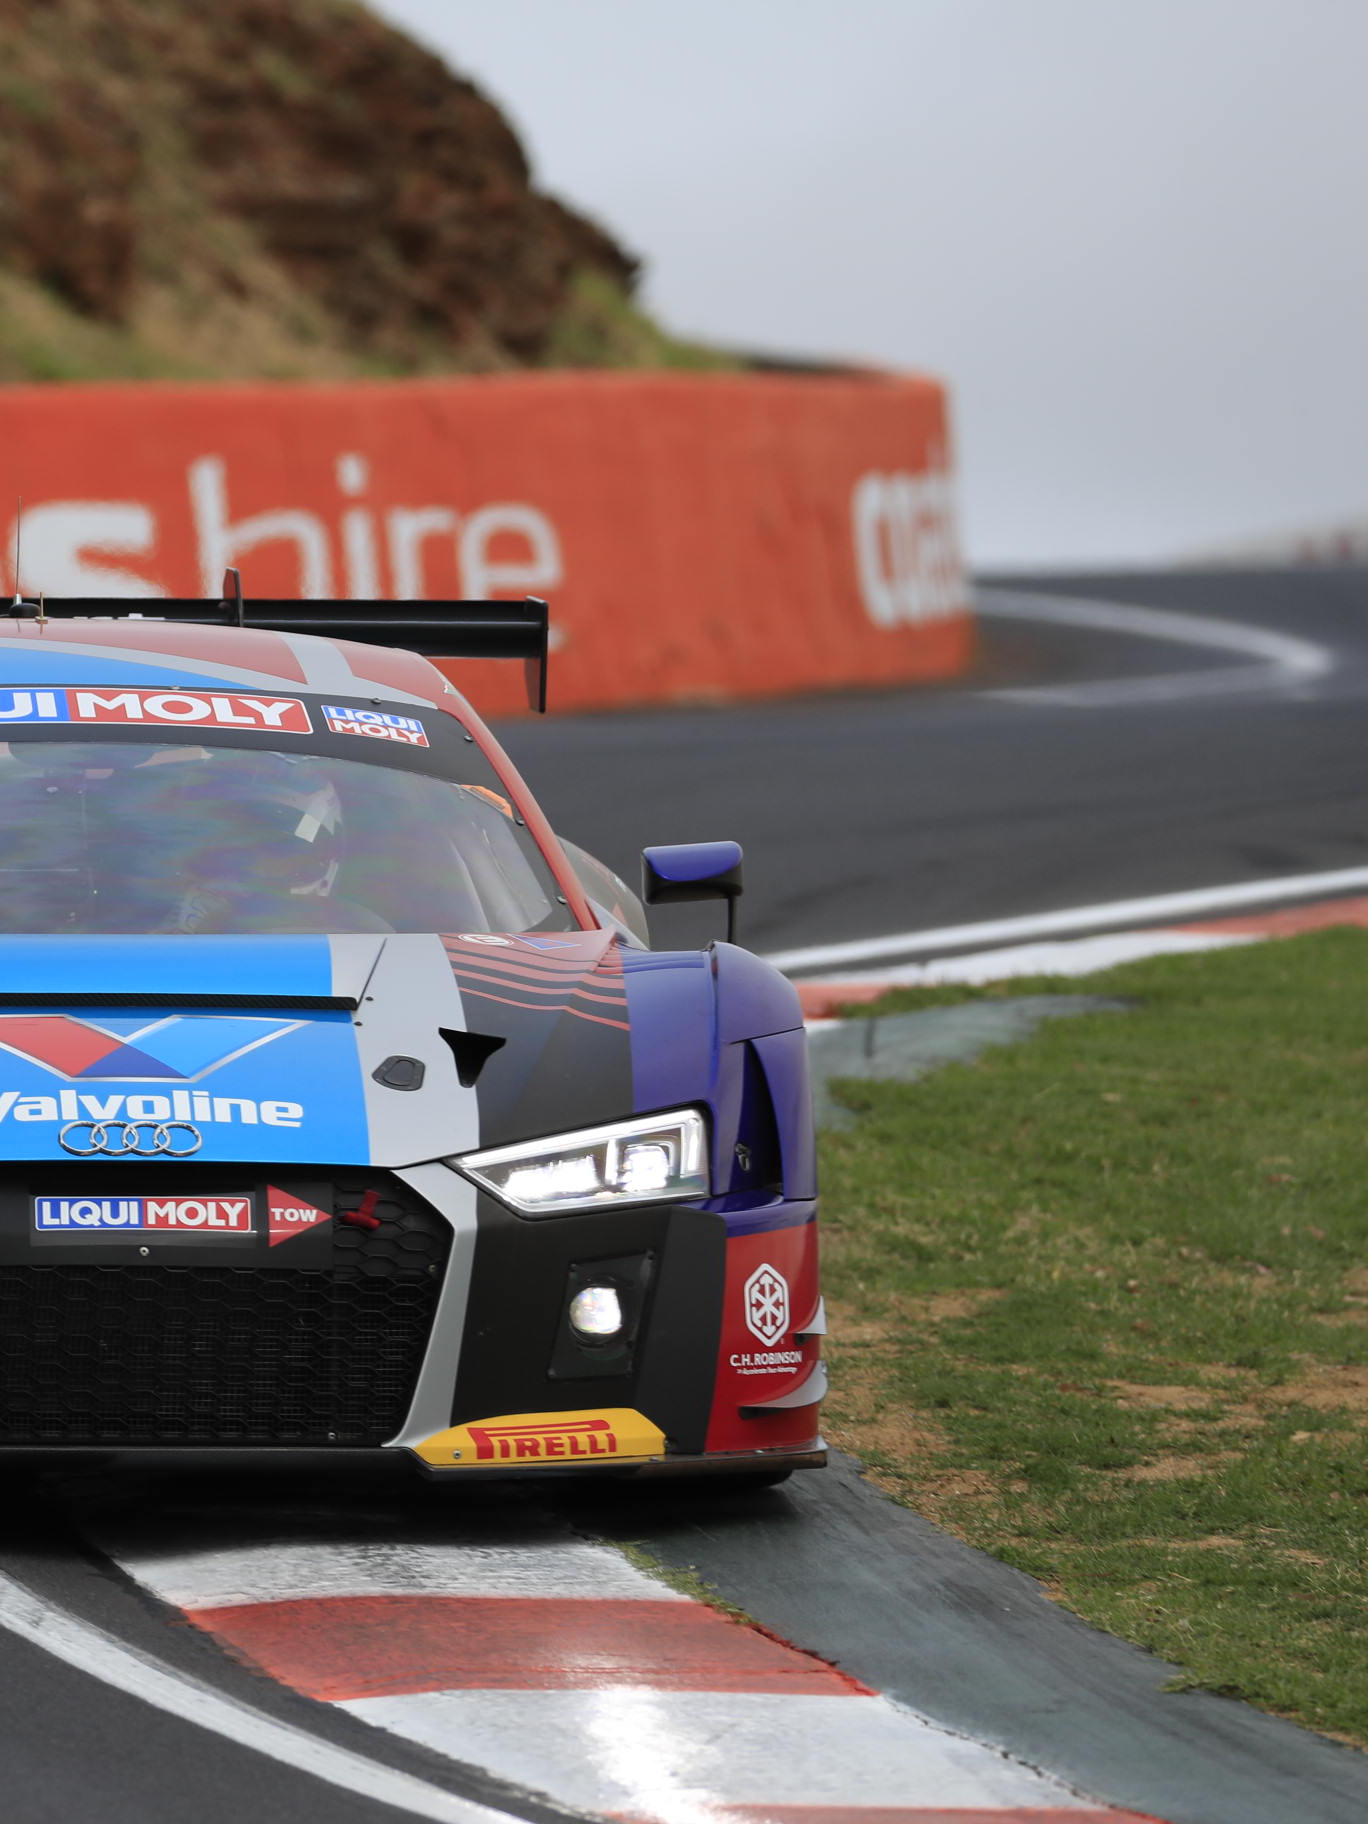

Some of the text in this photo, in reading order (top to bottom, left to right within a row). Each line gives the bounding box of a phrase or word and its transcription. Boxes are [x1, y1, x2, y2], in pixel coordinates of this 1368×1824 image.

[76, 692, 297, 727] MOLY
[327, 707, 418, 732] LIQUI
[332, 719, 424, 744] MOLY
[42, 1200, 247, 1228] LIQUI MOLY
[270, 1207, 318, 1223] TOW
[754, 1351, 803, 1366] ROBINSON
[467, 1419, 618, 1460] PIRELLI
